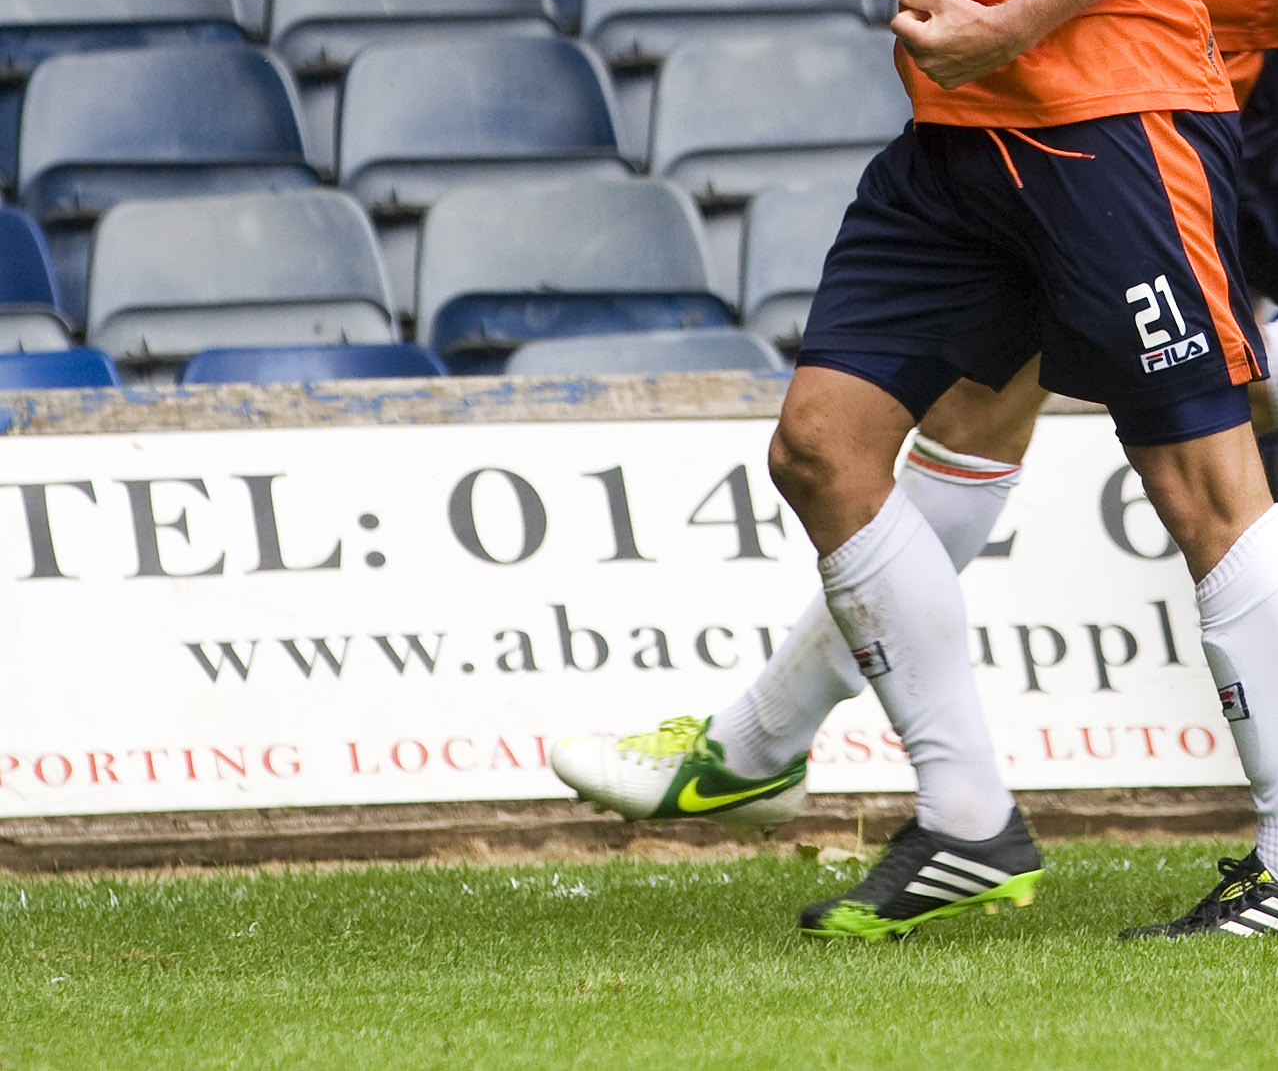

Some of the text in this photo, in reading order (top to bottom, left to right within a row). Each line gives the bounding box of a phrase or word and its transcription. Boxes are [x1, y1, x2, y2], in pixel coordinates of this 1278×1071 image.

[1125, 274, 1187, 350] 21
[1145, 340, 1204, 371] FILA
[1, 471, 387, 581] TEL:
